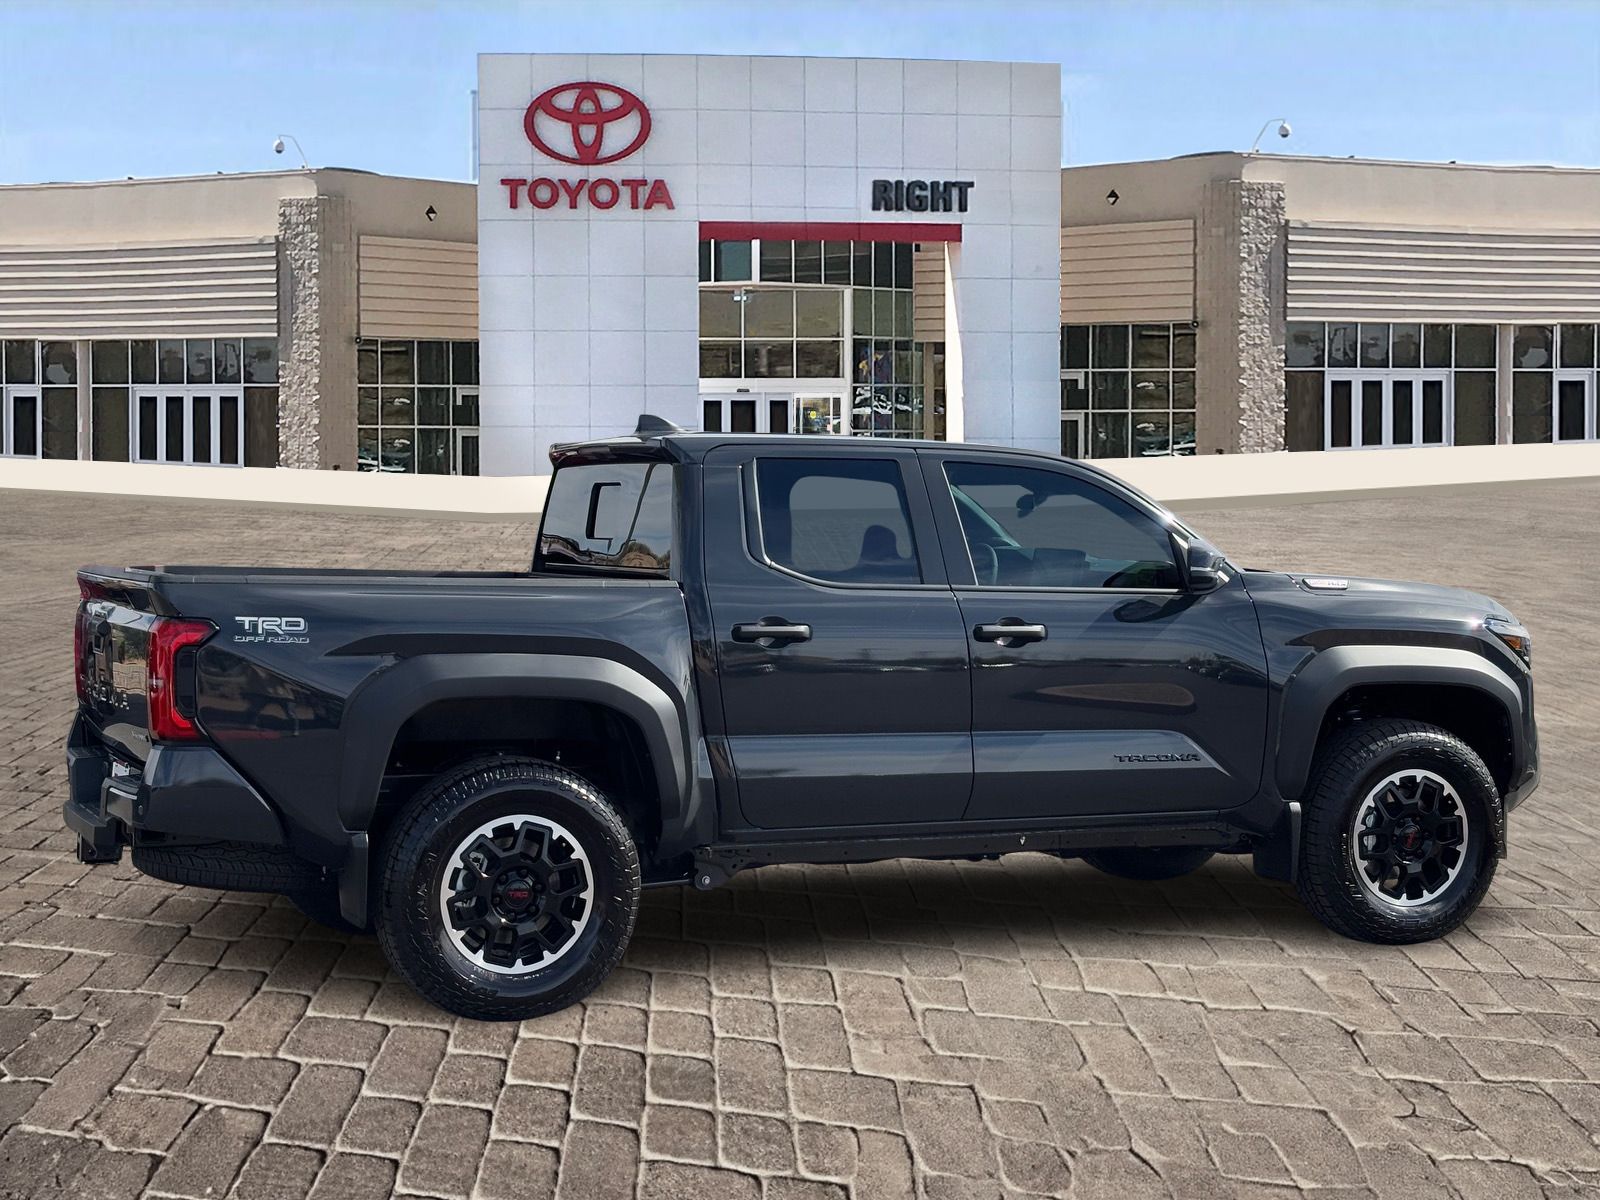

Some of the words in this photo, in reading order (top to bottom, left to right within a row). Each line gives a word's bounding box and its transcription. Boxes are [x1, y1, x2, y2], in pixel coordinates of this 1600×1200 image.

[500, 177, 676, 210] TOYOTA
[871, 179, 975, 213] RIGHT
[234, 616, 309, 636] TRD
[233, 634, 265, 643] OFF
[266, 634, 310, 644] ROAD
[1113, 752, 1201, 763] TACOMA
